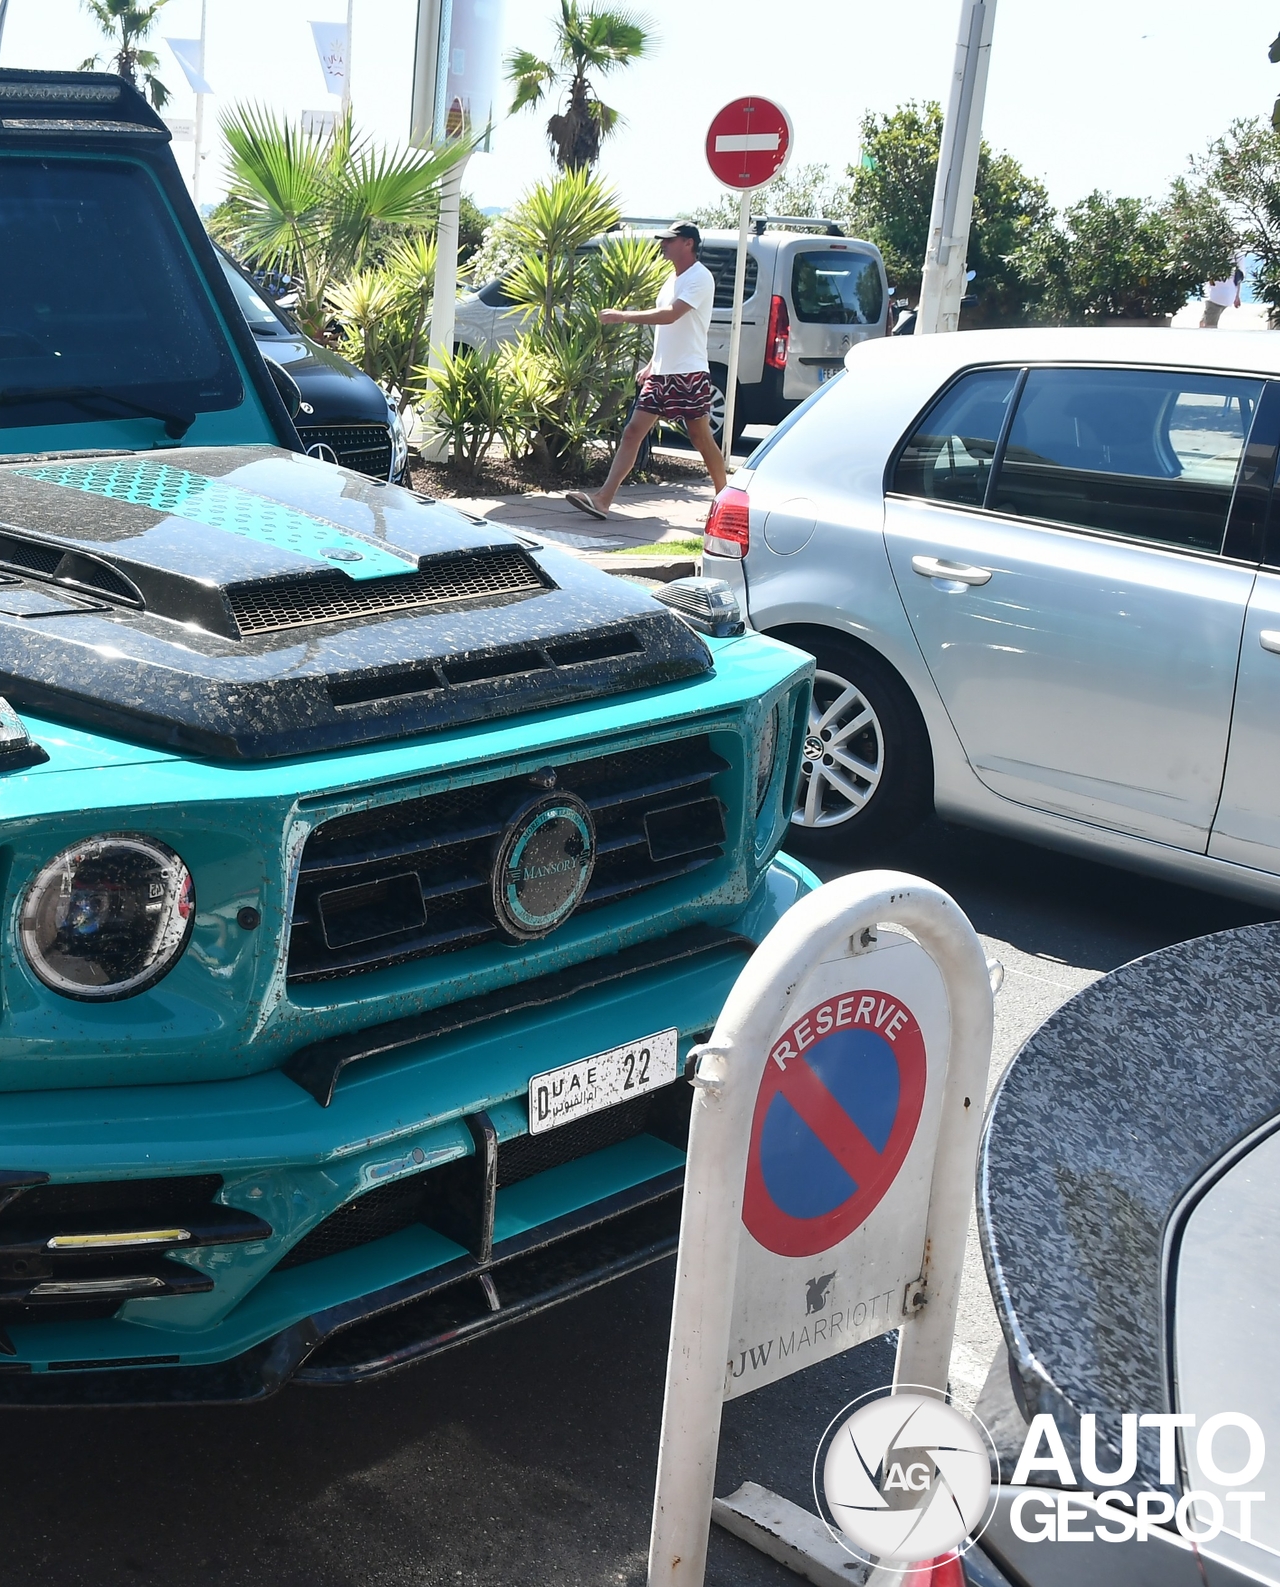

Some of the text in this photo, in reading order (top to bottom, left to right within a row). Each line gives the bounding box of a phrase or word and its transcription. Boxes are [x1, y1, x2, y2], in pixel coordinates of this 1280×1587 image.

[772, 996, 909, 1072] RESERVE
[537, 1086, 549, 1121] D
[623, 1048, 651, 1091] 22
[732, 1289, 896, 1378] JW MARRIOTT
